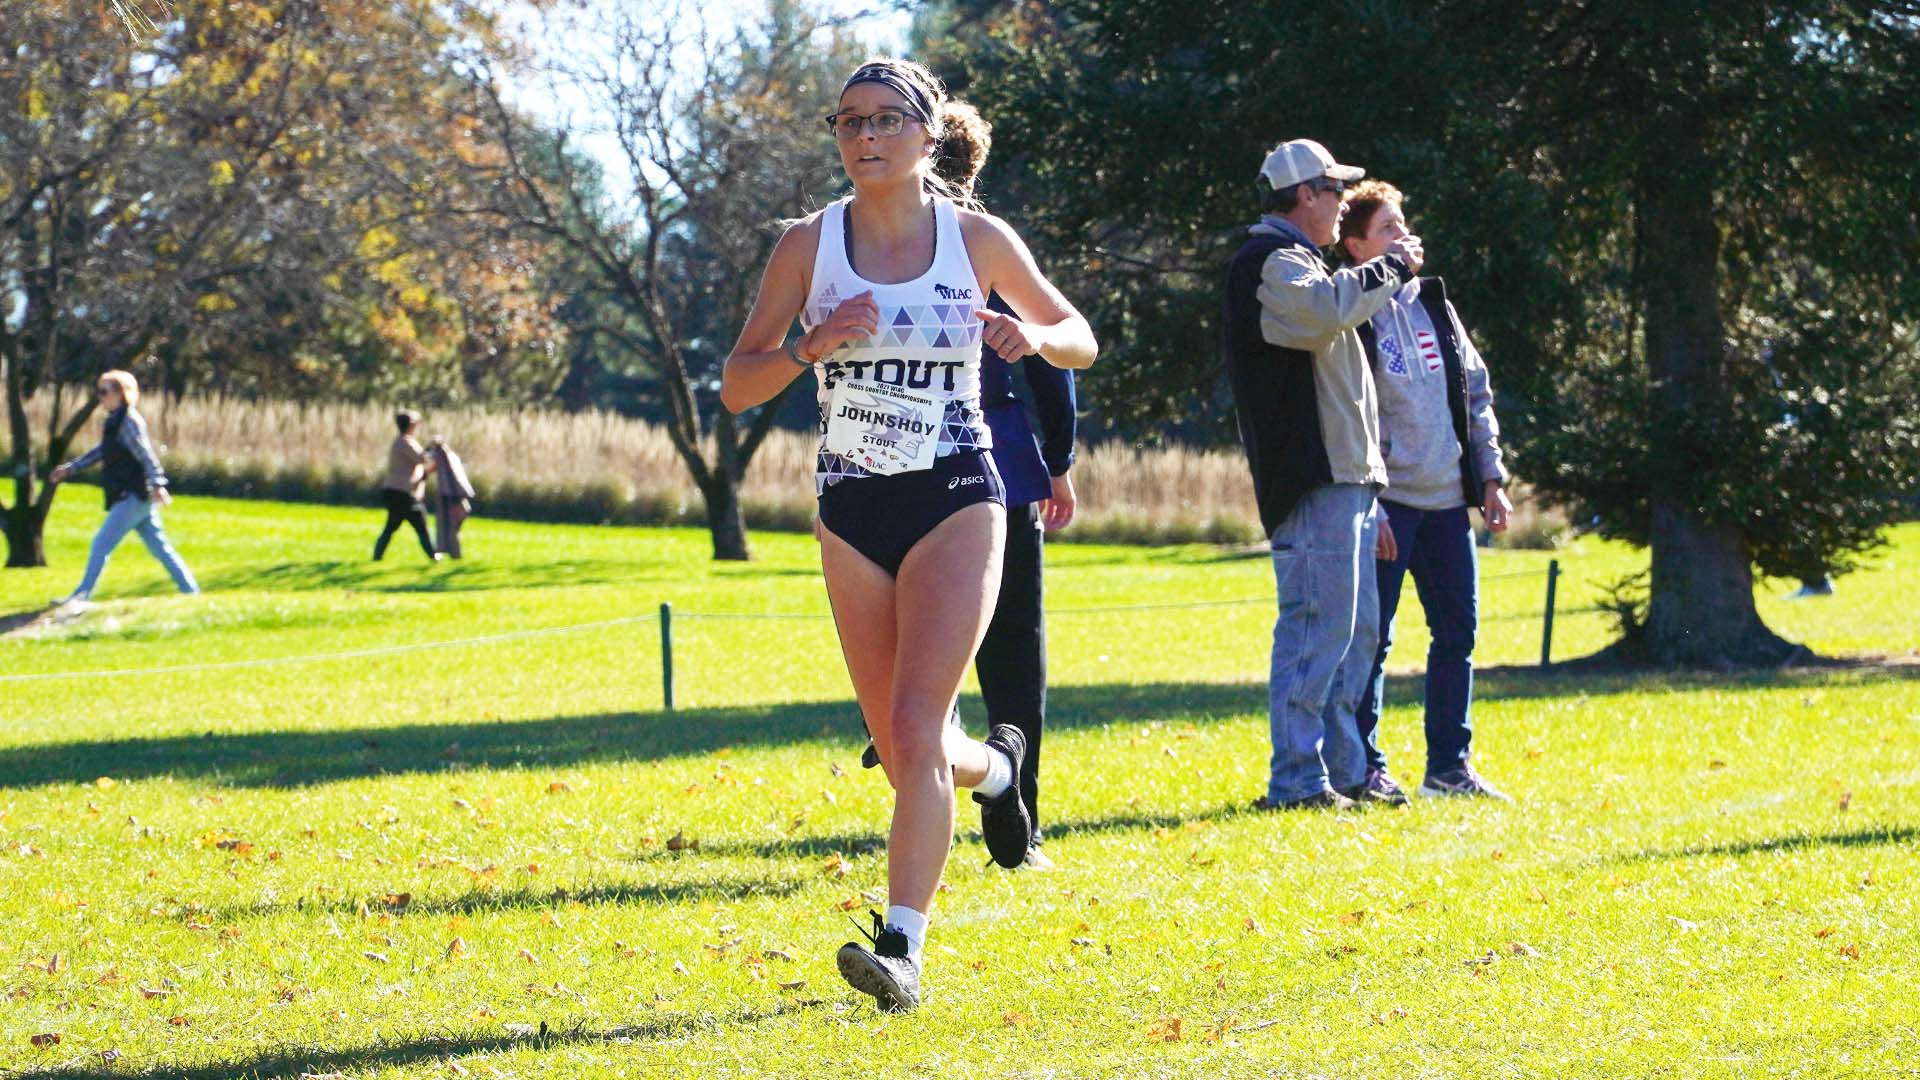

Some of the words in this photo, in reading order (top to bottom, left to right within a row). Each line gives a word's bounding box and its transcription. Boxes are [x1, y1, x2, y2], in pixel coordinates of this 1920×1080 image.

[937, 288, 972, 300] WIAC
[847, 382, 864, 390] CROSS
[865, 386, 888, 395] COUNTRY
[890, 391, 932, 405] CHAMPIONSHIPS
[837, 405, 936, 436] JOHNSHOY
[863, 435, 898, 448] STOUT
